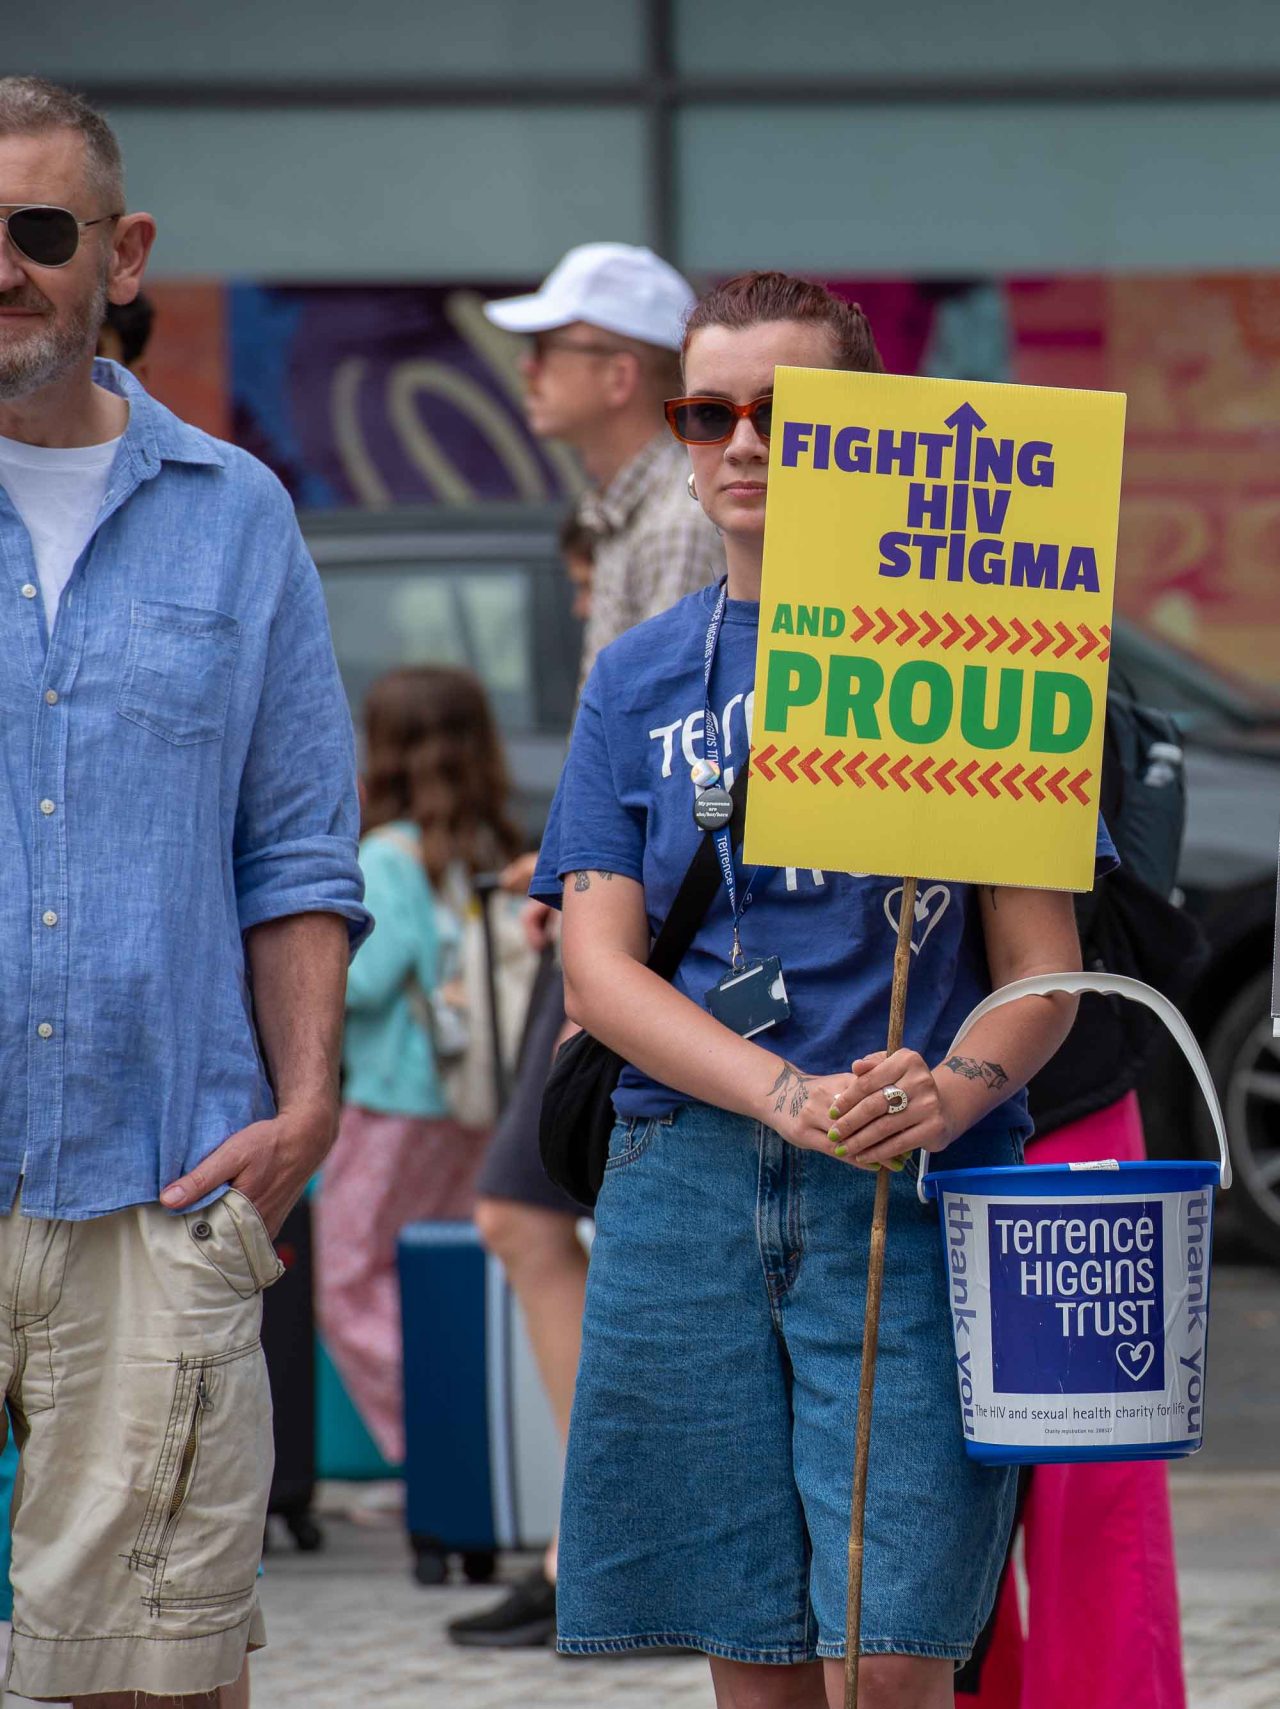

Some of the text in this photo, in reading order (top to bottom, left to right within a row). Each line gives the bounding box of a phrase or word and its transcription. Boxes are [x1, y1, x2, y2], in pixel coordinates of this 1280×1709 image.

[781, 417, 1055, 488] FIGHTING
[906, 482, 1012, 535] HIV
[877, 531, 1101, 594] STIGMA
[770, 603, 847, 639] AND
[763, 649, 1094, 754] PROUD
[717, 835, 734, 886] Terrence
[995, 1216, 1155, 1255] Terrence
[948, 1197, 977, 1436] thank you
[1179, 1191, 1208, 1434] thank you
[974, 1401, 1186, 1420] The HIV and sexual health charity for life
